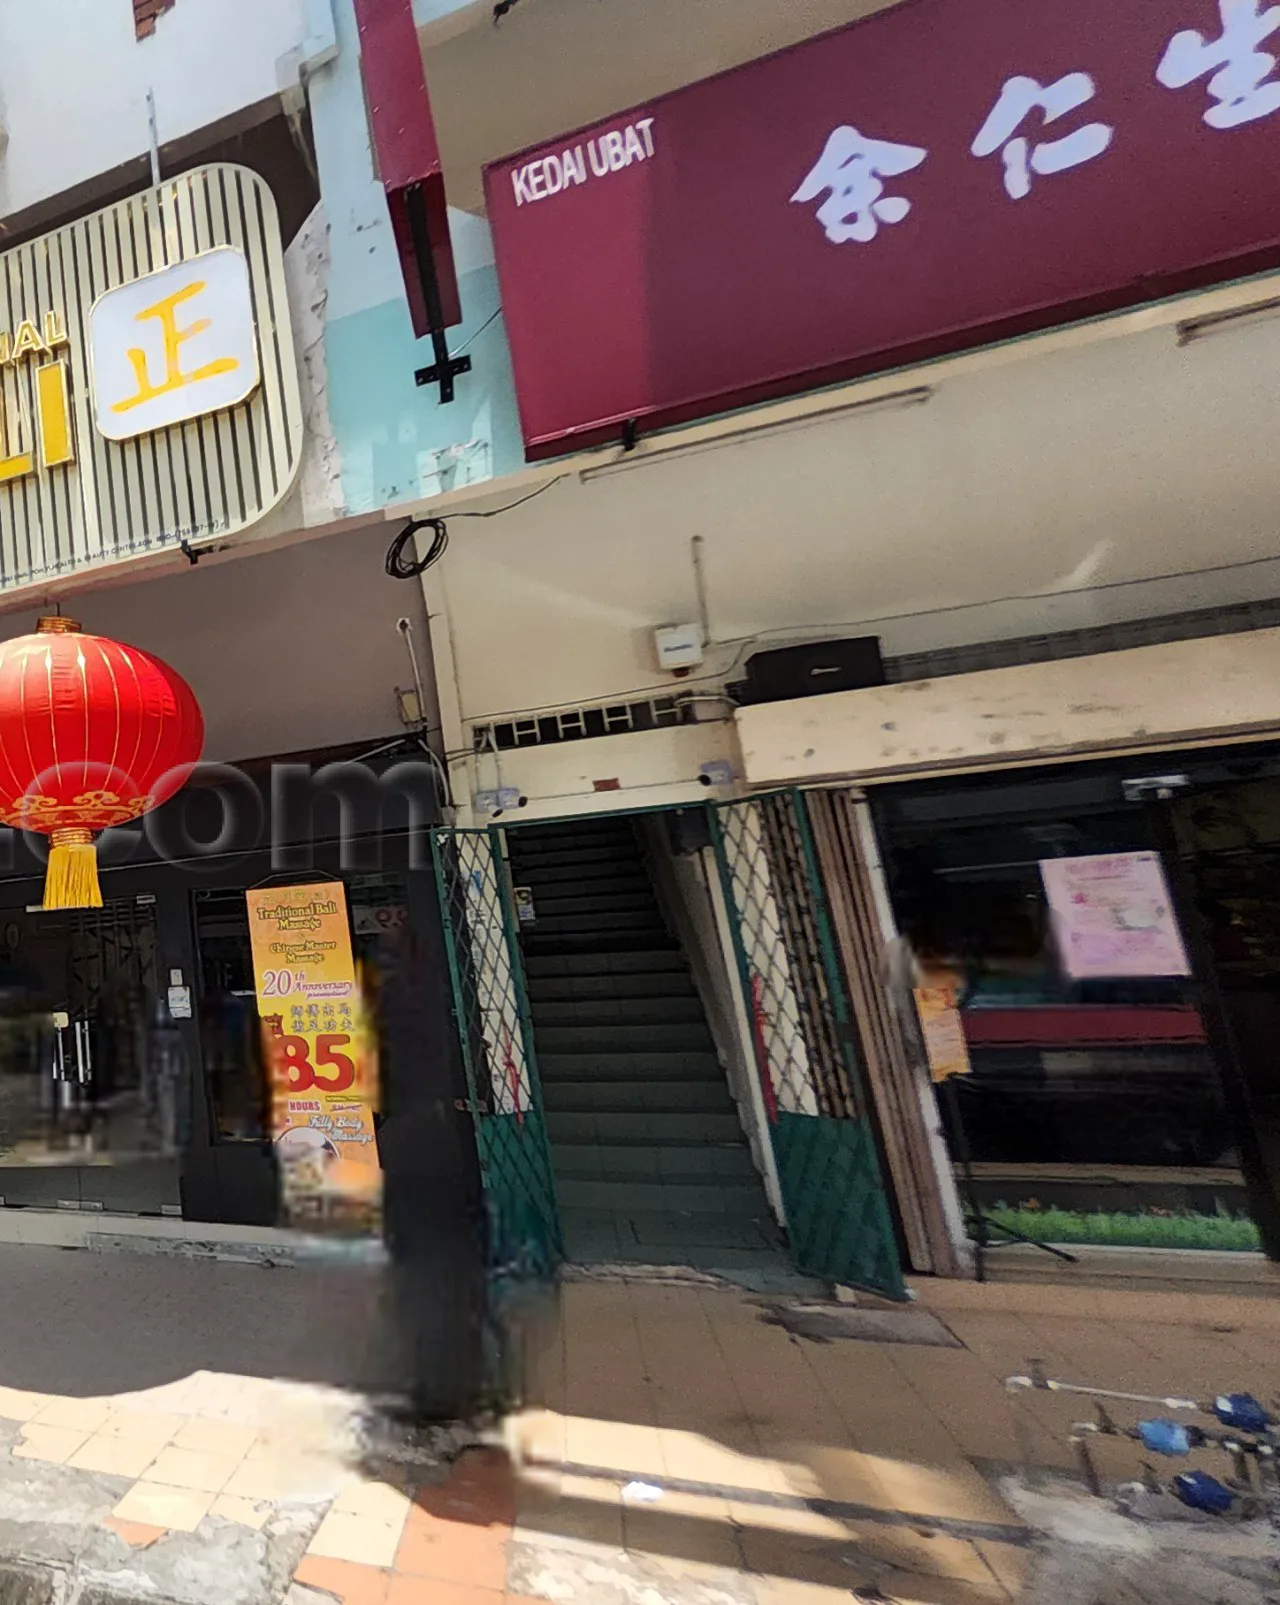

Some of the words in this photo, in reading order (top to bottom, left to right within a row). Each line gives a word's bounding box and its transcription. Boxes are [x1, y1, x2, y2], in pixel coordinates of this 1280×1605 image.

[511, 145, 587, 207] KEDAI
[587, 118, 655, 177] UBAT
[111, 281, 239, 413] 正
[257, 903, 314, 920] Traditional
[315, 901, 337, 915] Bali
[278, 917, 321, 931] Massage
[263, 970, 291, 996] 20
[289, 1101, 320, 1111] HOURS
